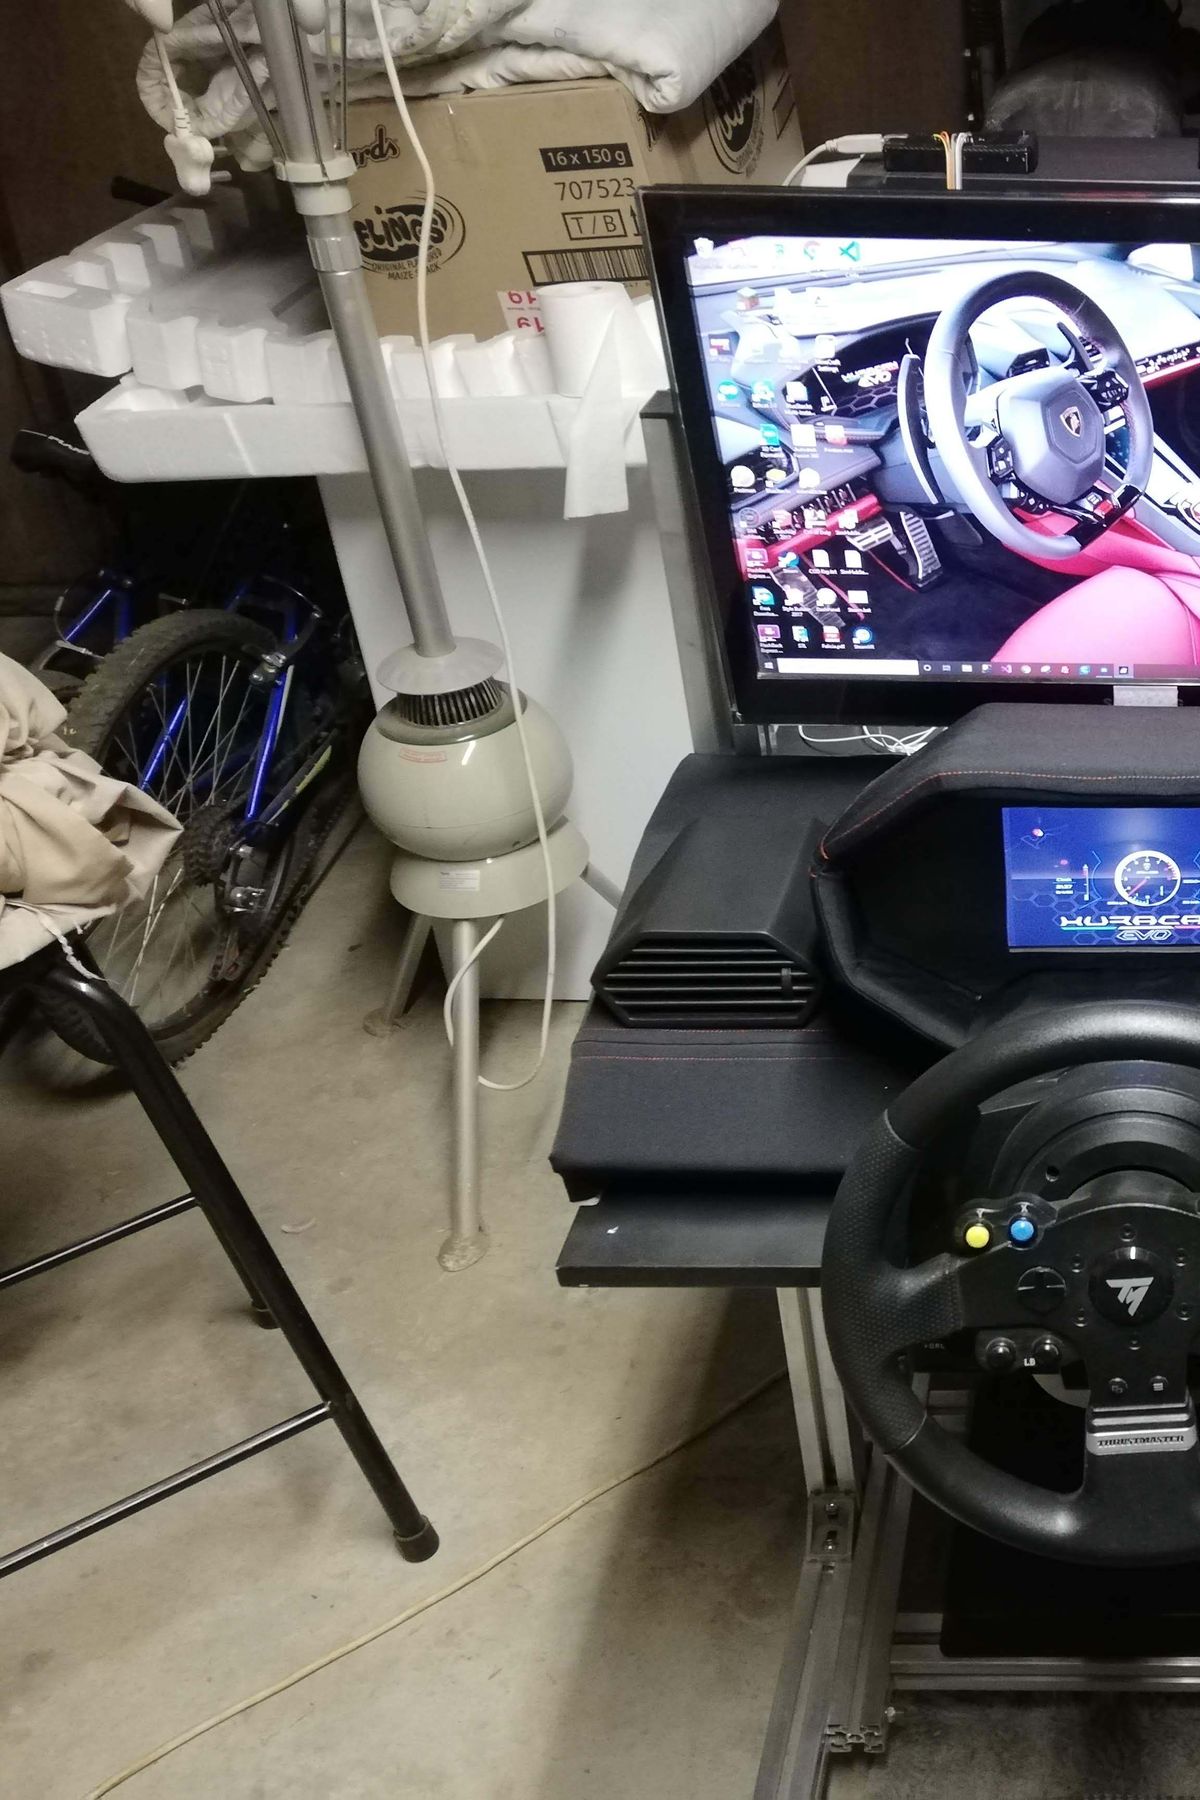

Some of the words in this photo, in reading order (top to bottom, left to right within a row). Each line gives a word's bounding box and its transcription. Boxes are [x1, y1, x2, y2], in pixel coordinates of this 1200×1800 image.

[548, 151, 567, 166] 16
[569, 156, 580, 166] x
[582, 149, 611, 163] 150
[615, 150, 626, 166] g
[554, 177, 636, 201] 707523
[388, 270, 414, 280] MAIZE
[1115, 929, 1174, 941] EVO
[1023, 1358, 1035, 1366] LB
[1097, 1435, 1184, 1447] THRUSTMASTER
